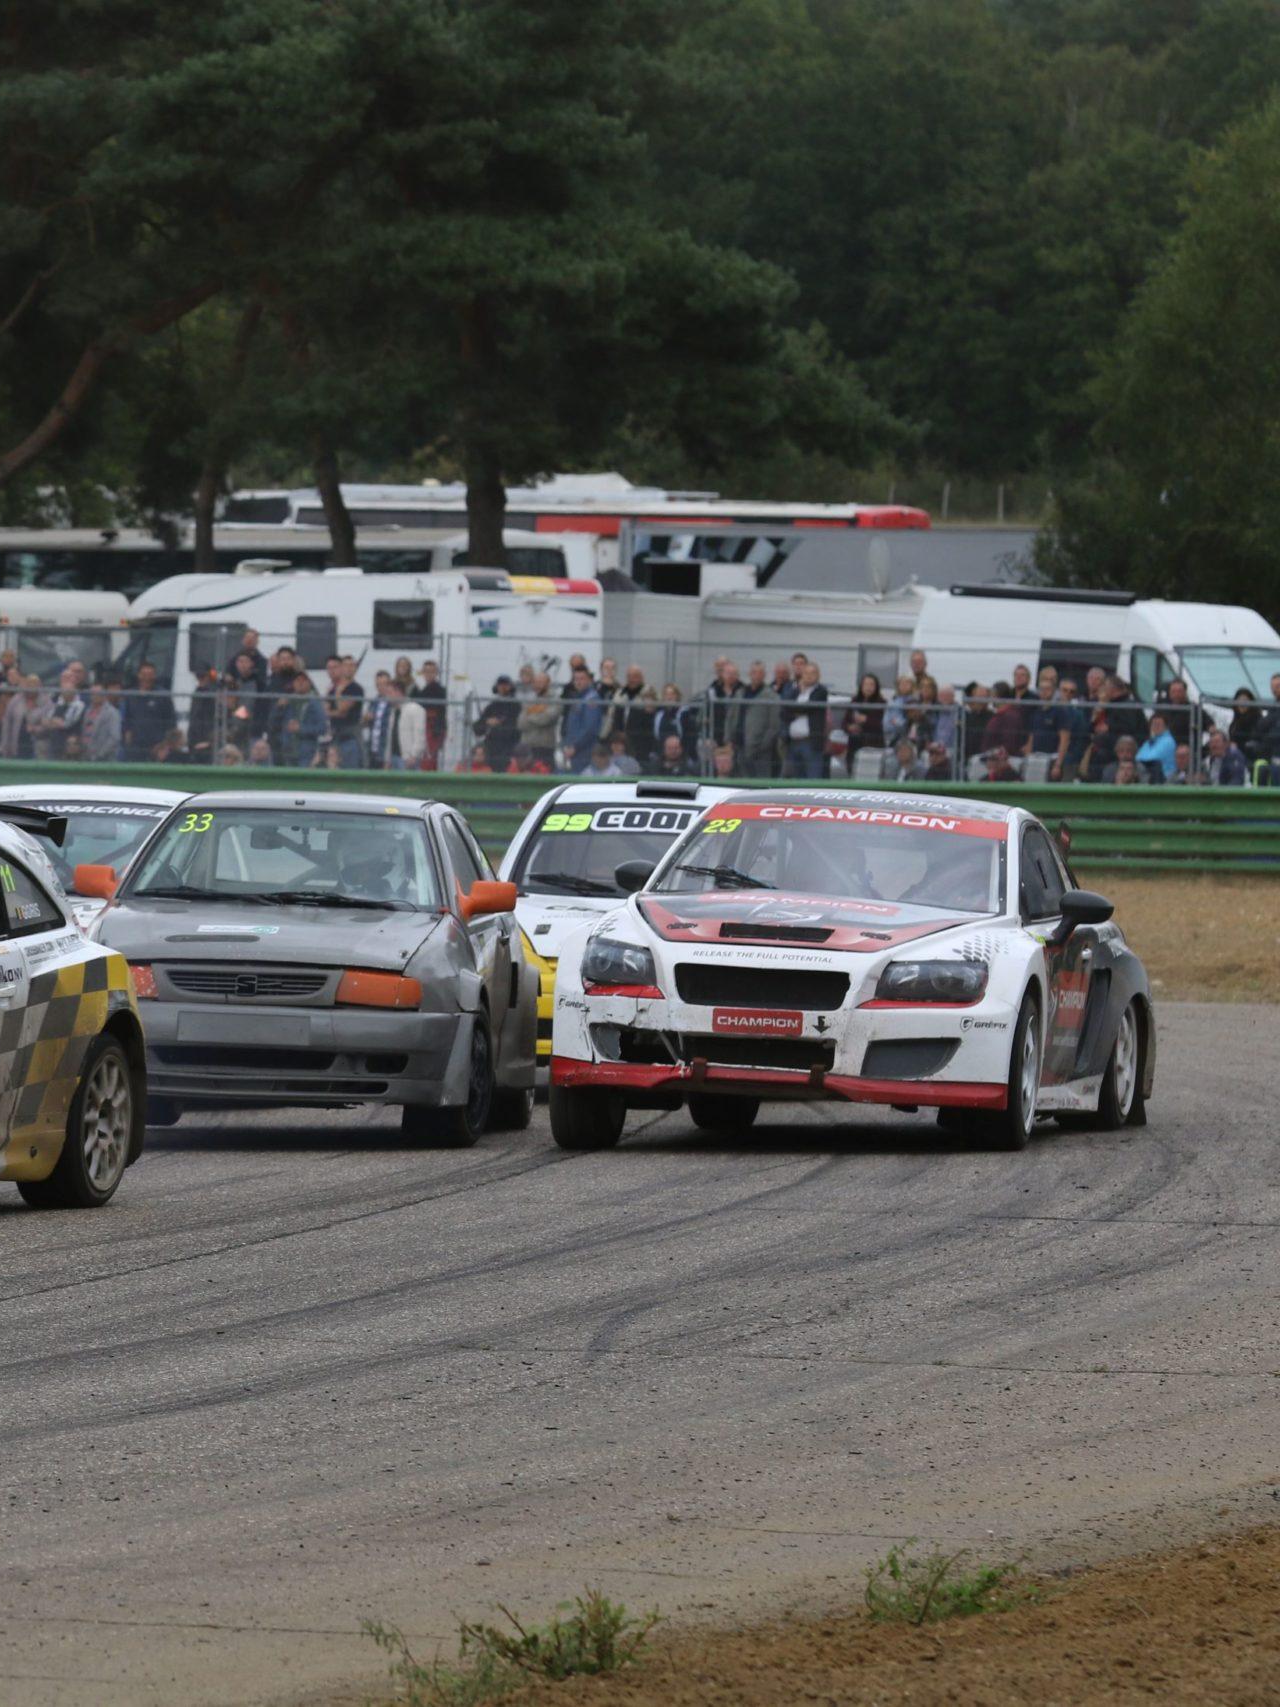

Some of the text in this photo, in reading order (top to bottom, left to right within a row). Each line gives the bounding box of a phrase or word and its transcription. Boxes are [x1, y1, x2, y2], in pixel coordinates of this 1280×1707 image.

[178, 813, 214, 832] 33
[541, 813, 593, 832] 99
[703, 819, 741, 834] 23
[759, 807, 956, 831] CHAMPION
[0, 864, 16, 892] 11
[711, 894, 889, 913] CHAMPION
[693, 950, 833, 964] RELEASE THE FULL POTENTIAL
[717, 1015, 799, 1029] CHAMPION
